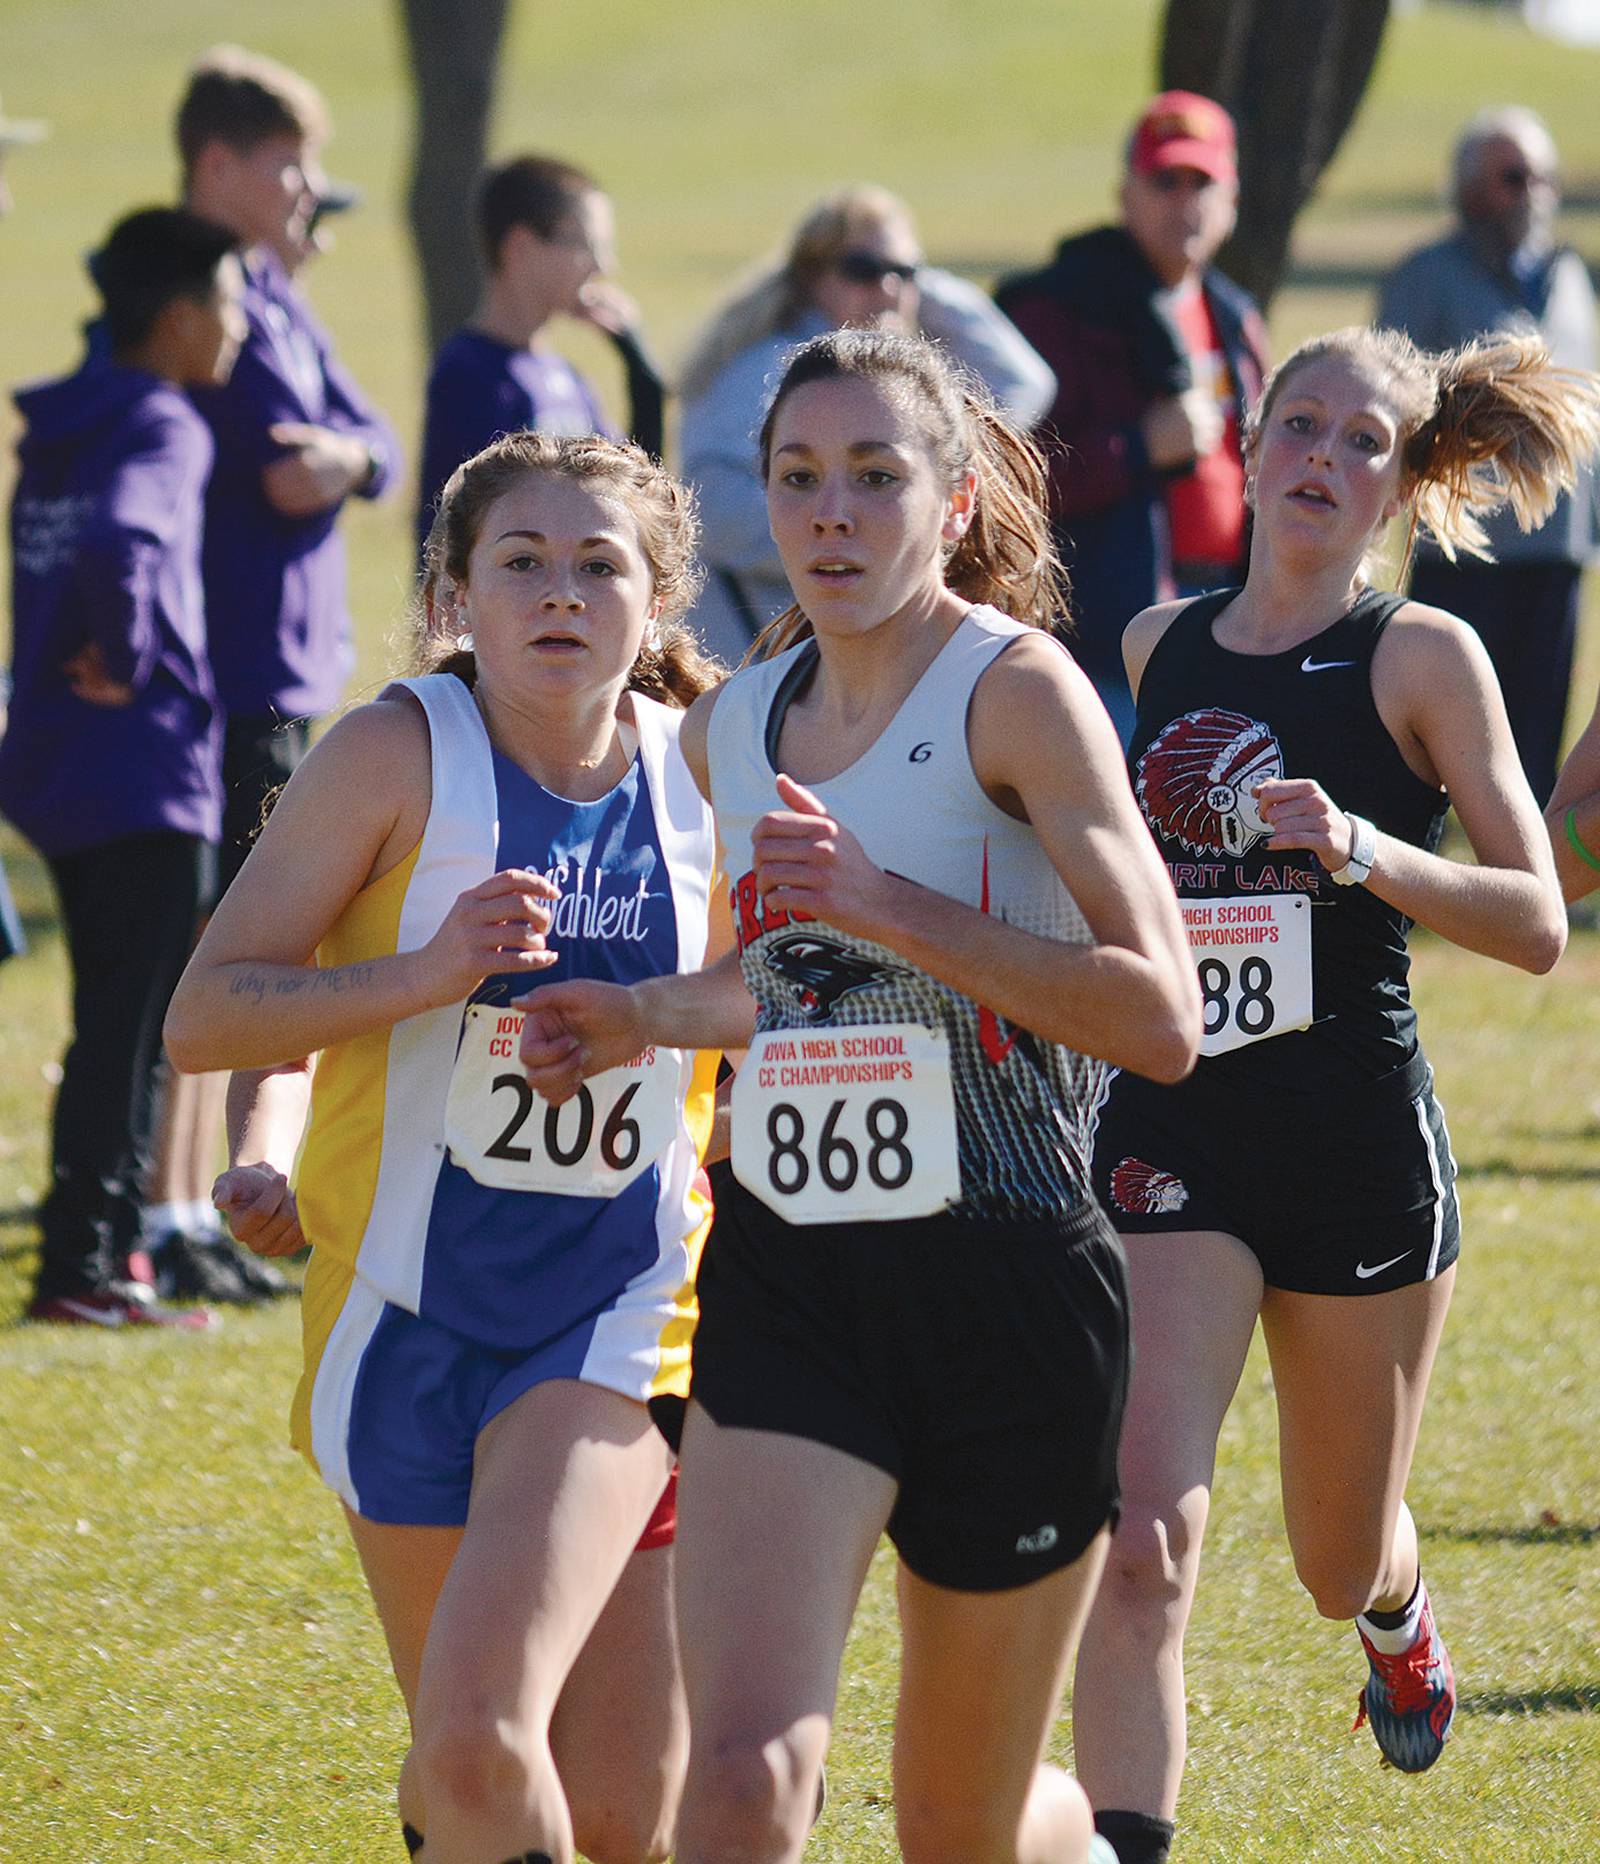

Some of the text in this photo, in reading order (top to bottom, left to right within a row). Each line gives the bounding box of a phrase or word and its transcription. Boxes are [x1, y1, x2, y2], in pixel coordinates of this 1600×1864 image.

[1181, 904, 1276, 926] HIGH SCHOOL
[1187, 926, 1279, 947] MPIONSHIPS
[1197, 956, 1275, 1035] 88
[489, 1039, 512, 1057] CC
[762, 1036, 907, 1063] IOWA HIGH SCHOOL
[758, 1060, 913, 1088] CC CHAMPIONSHIPS
[484, 1074, 643, 1170] 206
[767, 1097, 913, 1195] 868
